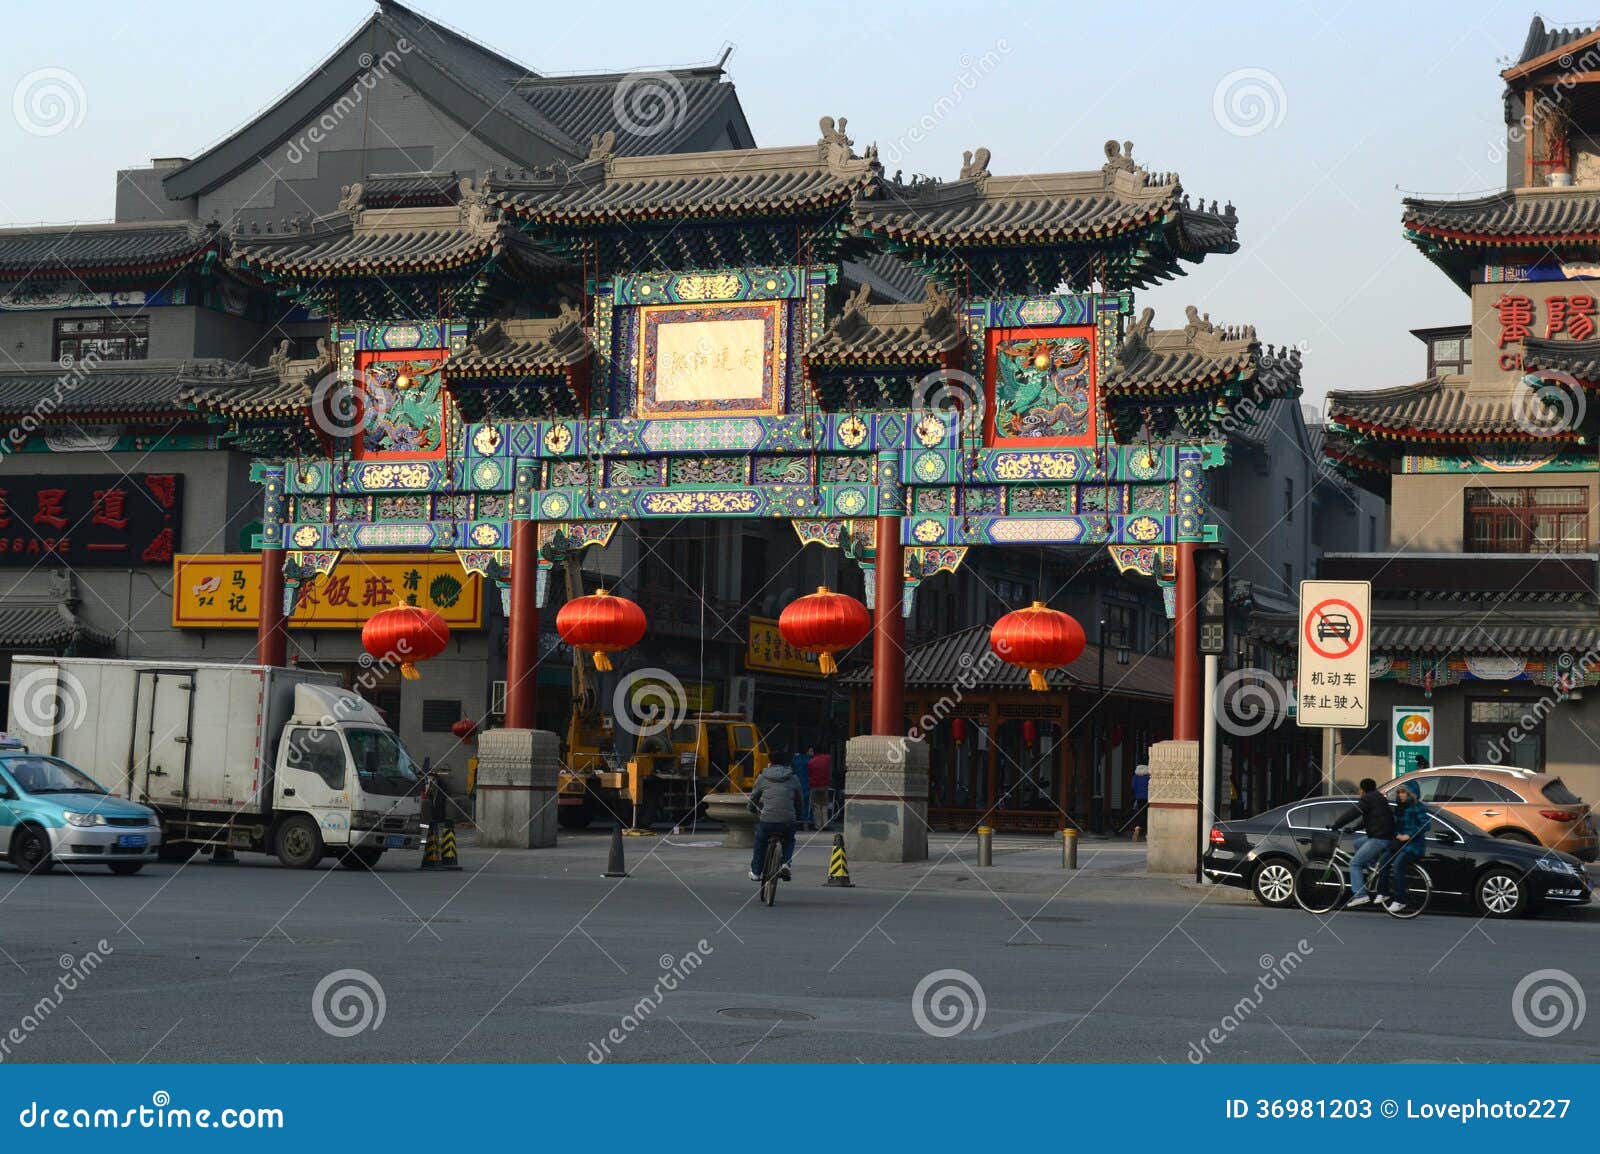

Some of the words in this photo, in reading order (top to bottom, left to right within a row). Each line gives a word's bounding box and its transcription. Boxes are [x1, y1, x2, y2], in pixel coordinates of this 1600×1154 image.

[0, 489, 129, 530] 足道
[228, 569, 247, 613] 马记
[1311, 671, 1357, 686] 机动车
[1302, 695, 1364, 710] 禁止驶入
[1406, 719, 1428, 735] 24h
